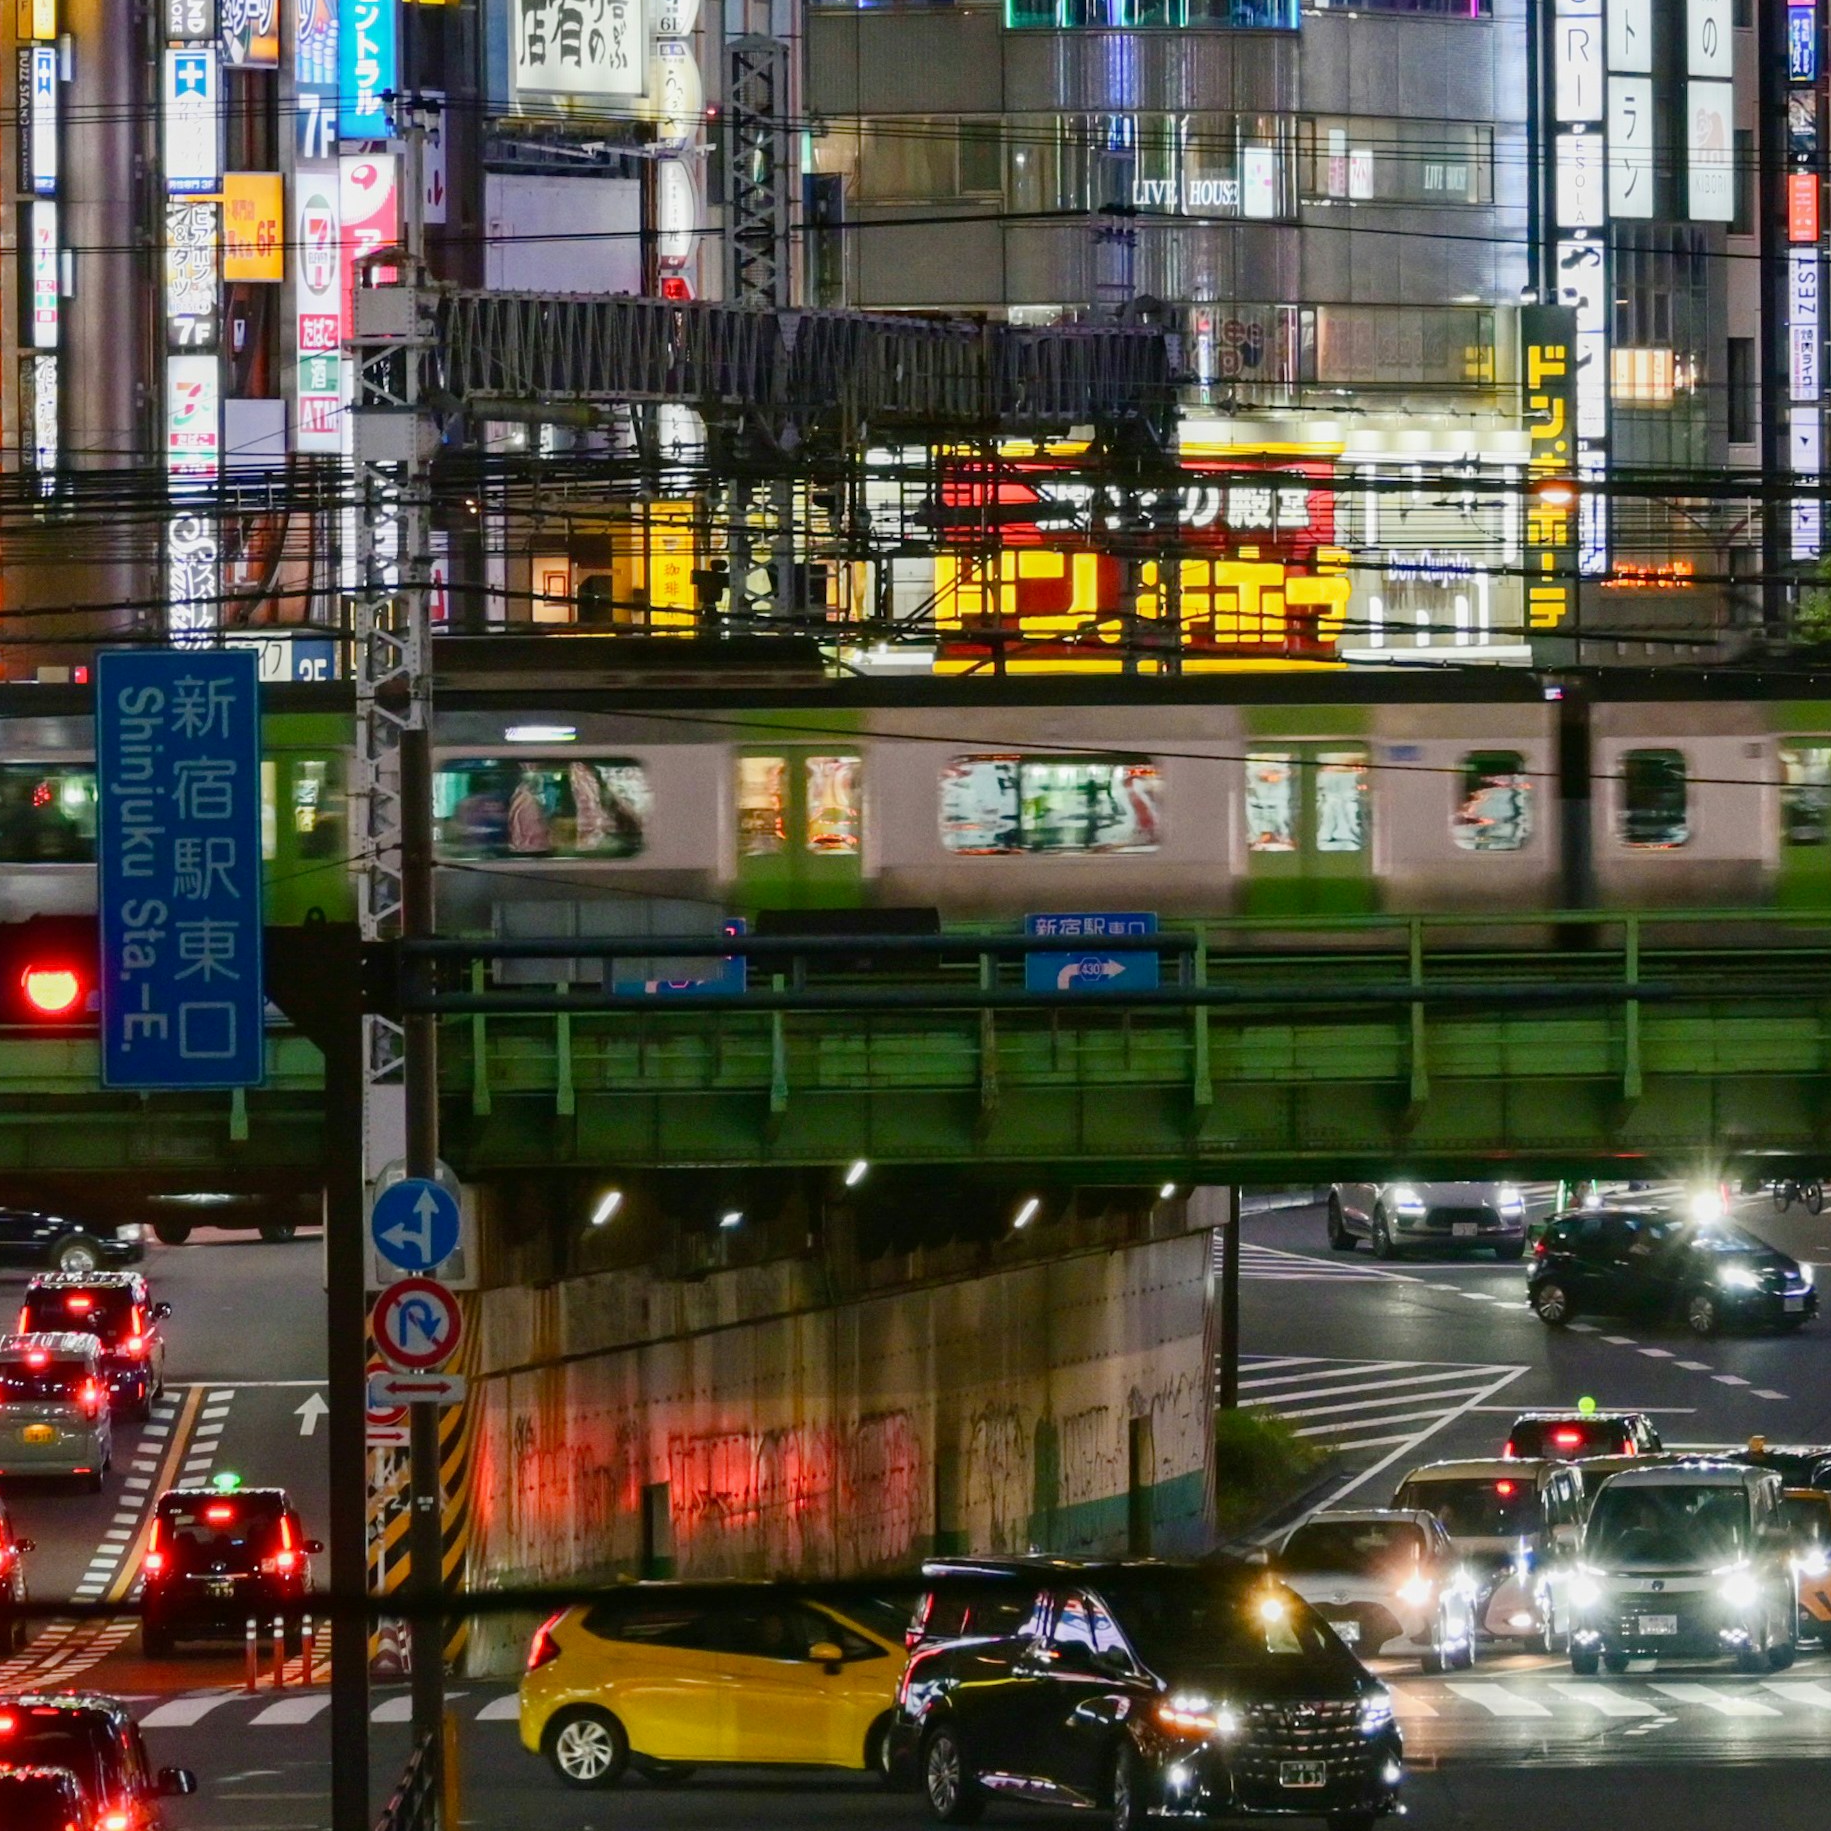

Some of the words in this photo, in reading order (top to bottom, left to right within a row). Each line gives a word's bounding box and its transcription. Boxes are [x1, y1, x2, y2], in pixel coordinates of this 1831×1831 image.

[660, 16, 681, 32] 6F
[298, 92, 338, 160] 7F
[1131, 179, 1178, 206] LIVE
[1188, 178, 1241, 207] HOUSE
[1424, 164, 1444, 190] LIVE
[191, 207, 212, 282] ビアポン
[257, 219, 277, 258] 6F
[173, 317, 212, 346] 7F
[302, 318, 339, 349] たばこ
[301, 398, 339, 432] ATM
[1388, 550, 1417, 581] Don
[1419, 549, 1472, 588] Quijote
[113, 684, 164, 880] Shinjuku
[170, 673, 238, 1060] 新宿駅東口
[1035, 917, 1147, 936] 新宿駅東口
[1081, 961, 1102, 976] 430
